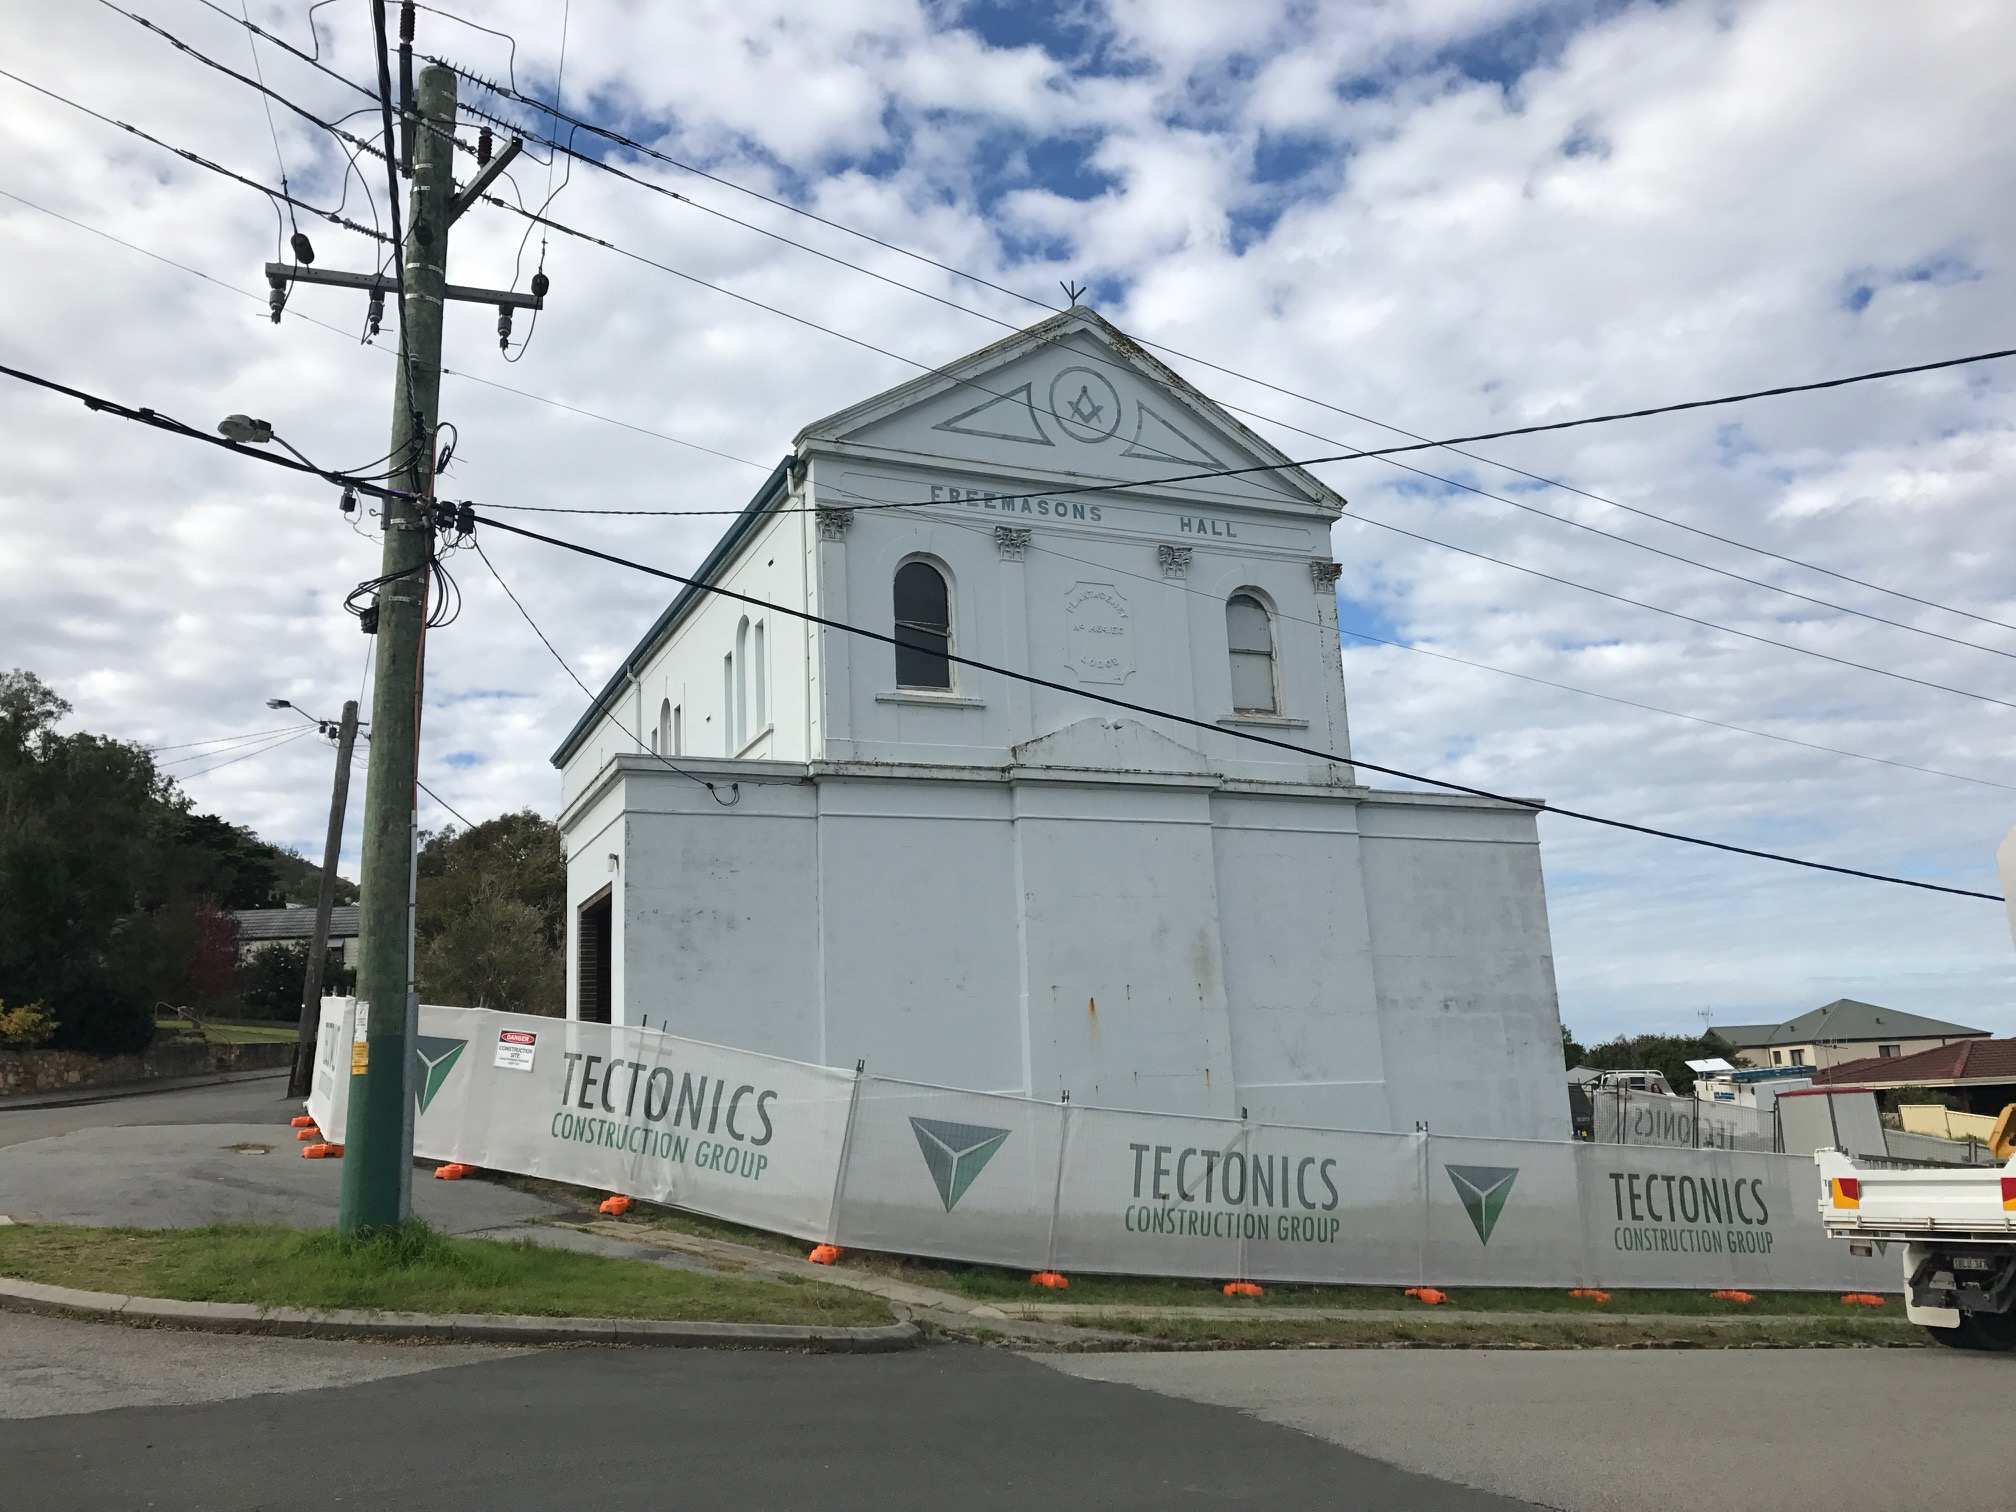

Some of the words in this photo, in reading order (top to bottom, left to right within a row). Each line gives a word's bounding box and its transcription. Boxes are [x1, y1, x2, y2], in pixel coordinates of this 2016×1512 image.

[929, 485, 1103, 522] FREEMASONS
[1179, 516, 1238, 538] HALL
[506, 1034, 530, 1043] DANGER
[562, 1052, 778, 1146] TECTONICS
[551, 1112, 689, 1164] CONSTRUCTION
[695, 1140, 768, 1181] GROUP
[1129, 1143, 1339, 1212] TECTONICS
[1609, 1173, 1769, 1226] TECTONICS
[1125, 1205, 1269, 1241] CONSTRUCTION
[1277, 1215, 1340, 1243] GROUP
[1614, 1227, 1723, 1253] CONSTRUCTION
[1727, 1230, 1774, 1254] GROUP
